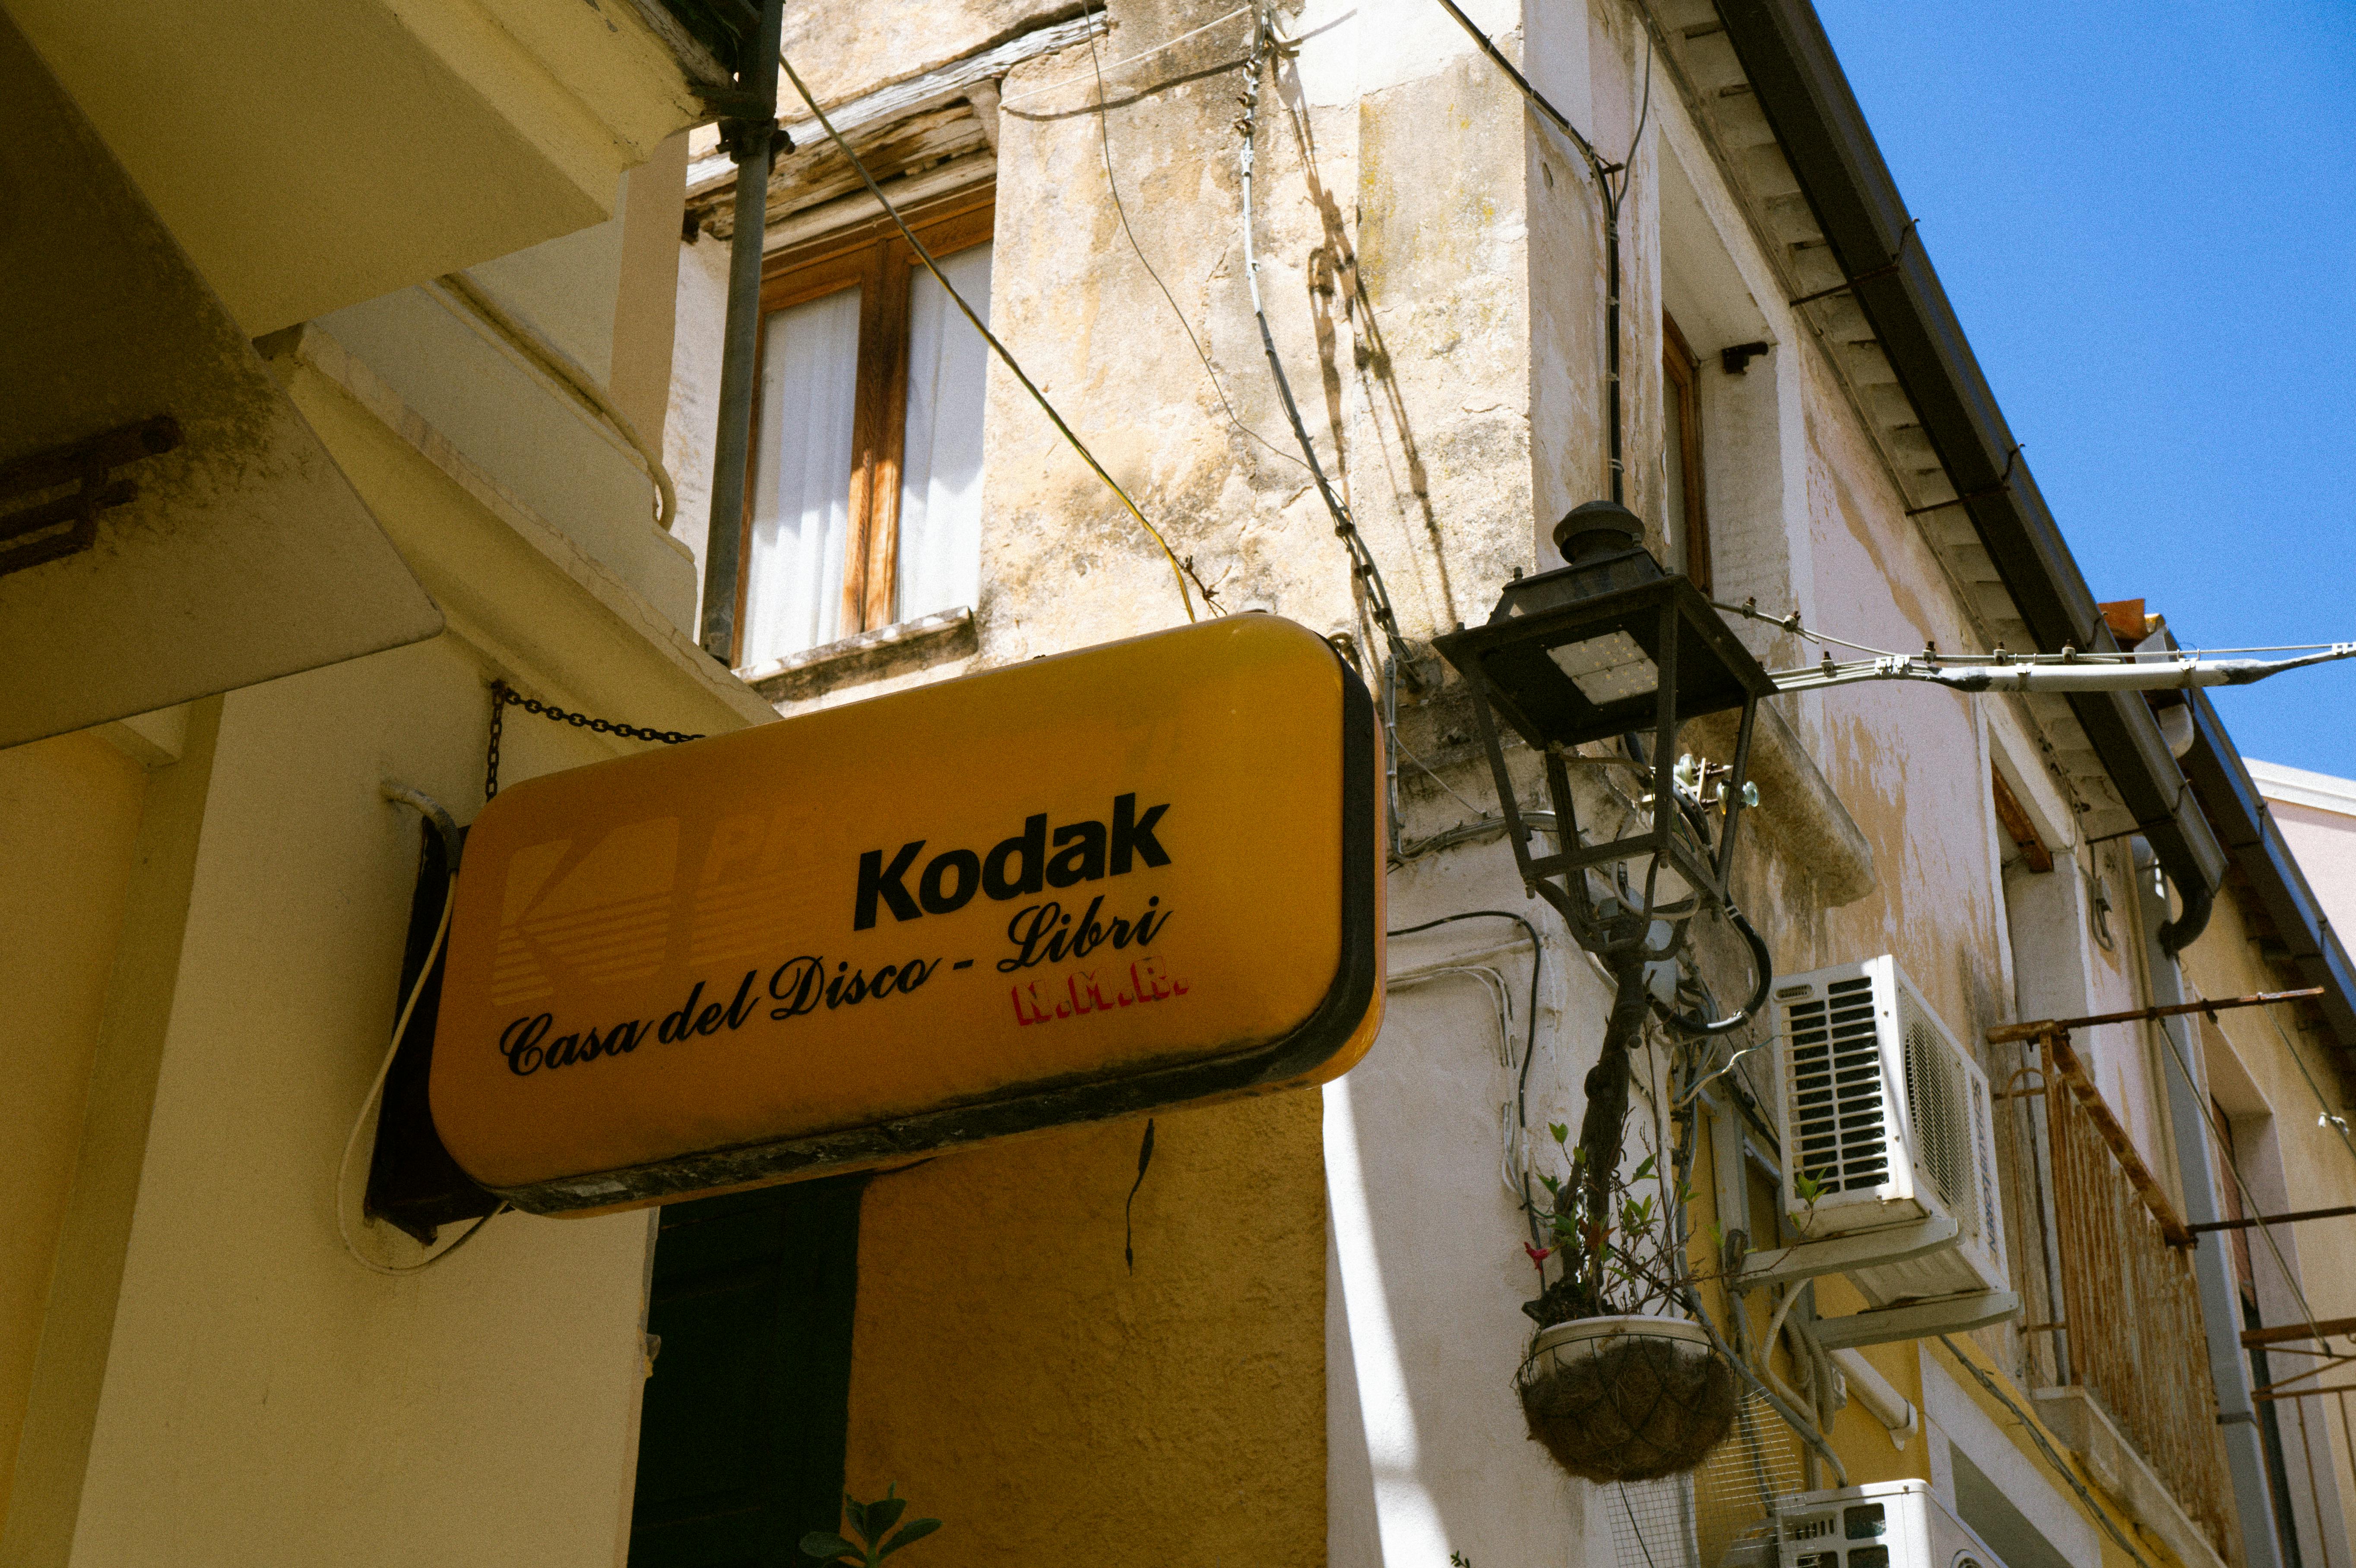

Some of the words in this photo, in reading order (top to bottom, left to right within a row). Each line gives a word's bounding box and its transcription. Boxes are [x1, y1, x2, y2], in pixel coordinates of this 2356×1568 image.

[854, 792, 1172, 931] Kodak
[499, 1012, 655, 1076] Casa
[657, 969, 761, 1044] del
[769, 956, 942, 1021] Disco
[997, 895, 1173, 973] Libri
